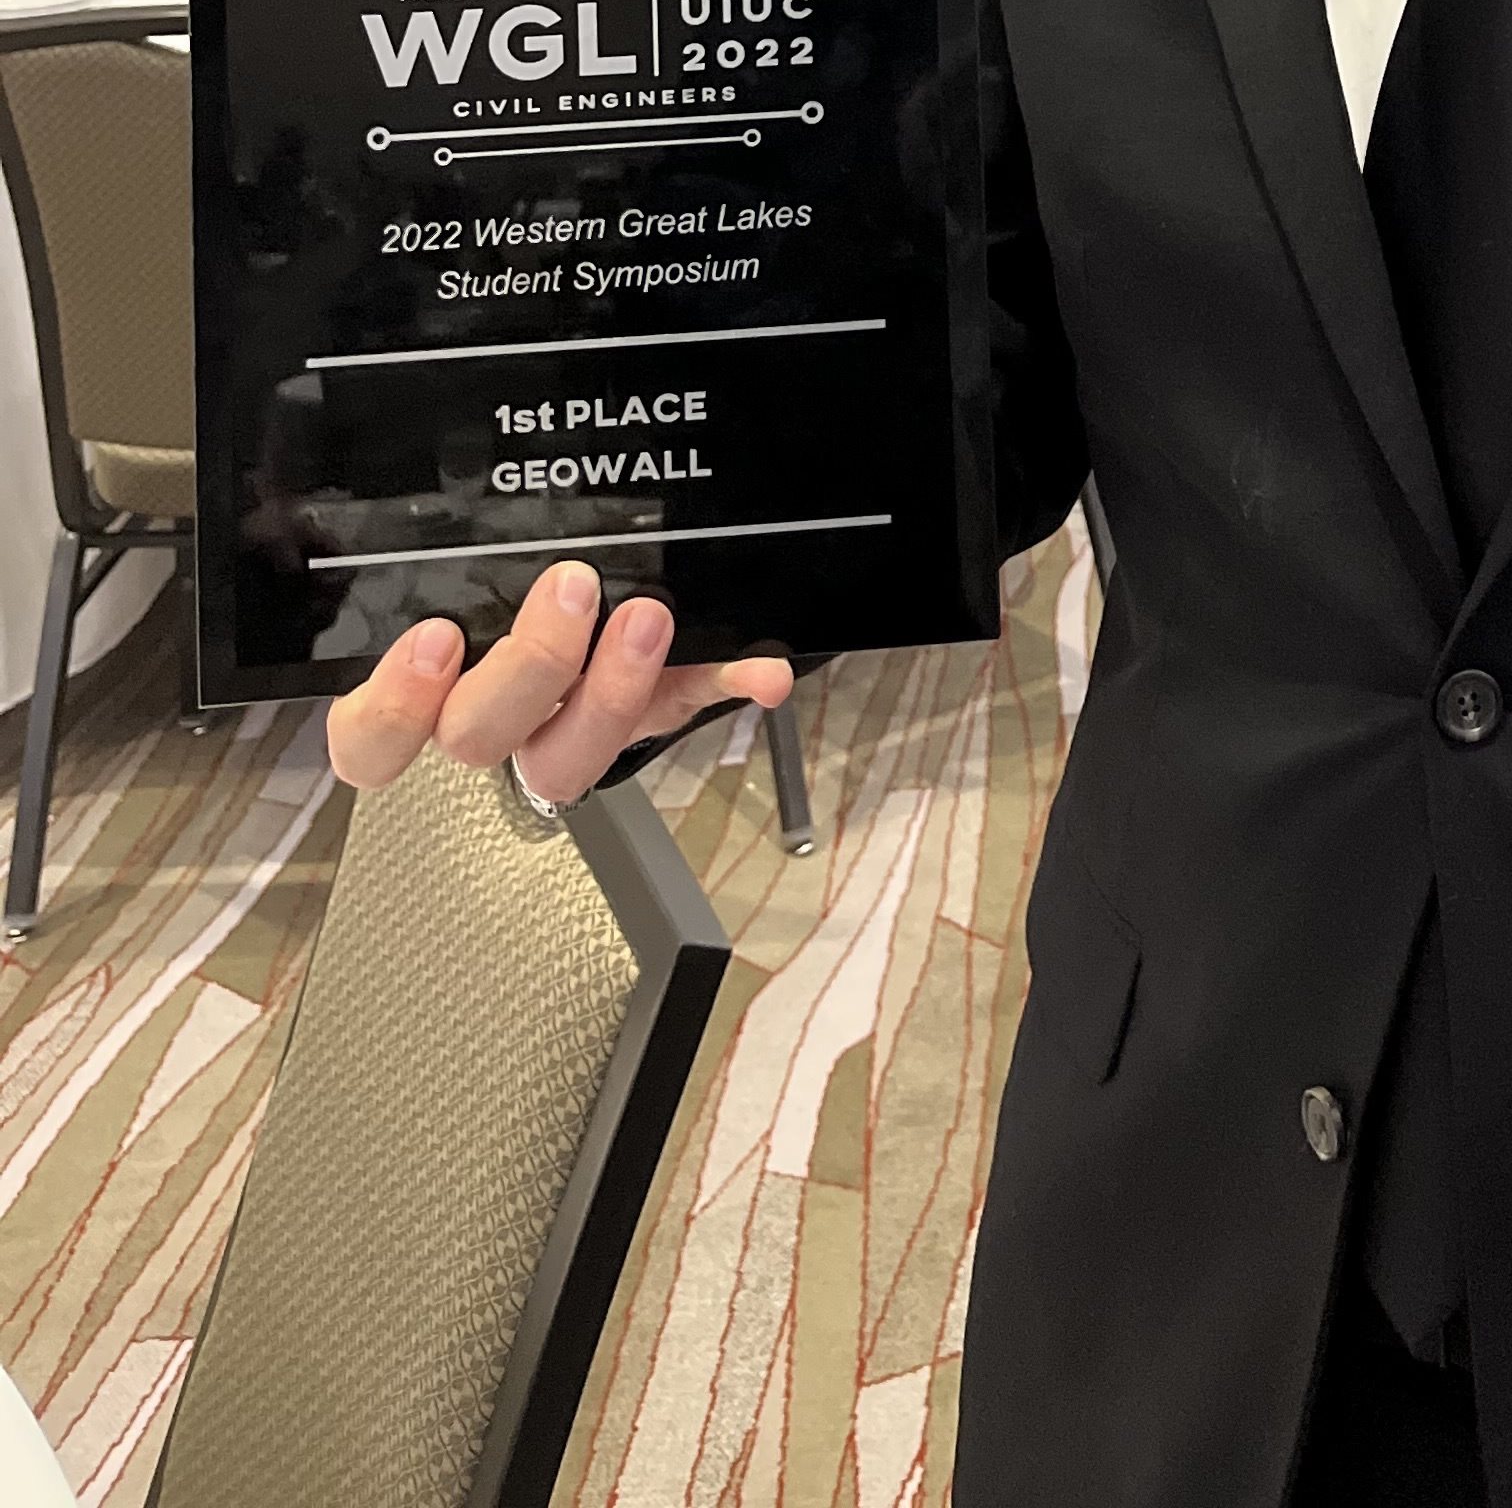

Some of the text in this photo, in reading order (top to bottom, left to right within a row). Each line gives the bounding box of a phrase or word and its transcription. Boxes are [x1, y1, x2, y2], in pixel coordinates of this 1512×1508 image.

[361, 2, 637, 88] WGL
[682, 37, 813, 71] 2022
[453, 86, 735, 117] CIVIL ENGINEERS
[381, 201, 812, 253] 2022 Western Great Lakes
[437, 254, 759, 299] Student Symposium
[495, 391, 707, 434] 1st PLACE
[492, 448, 712, 492] GEOWALL
